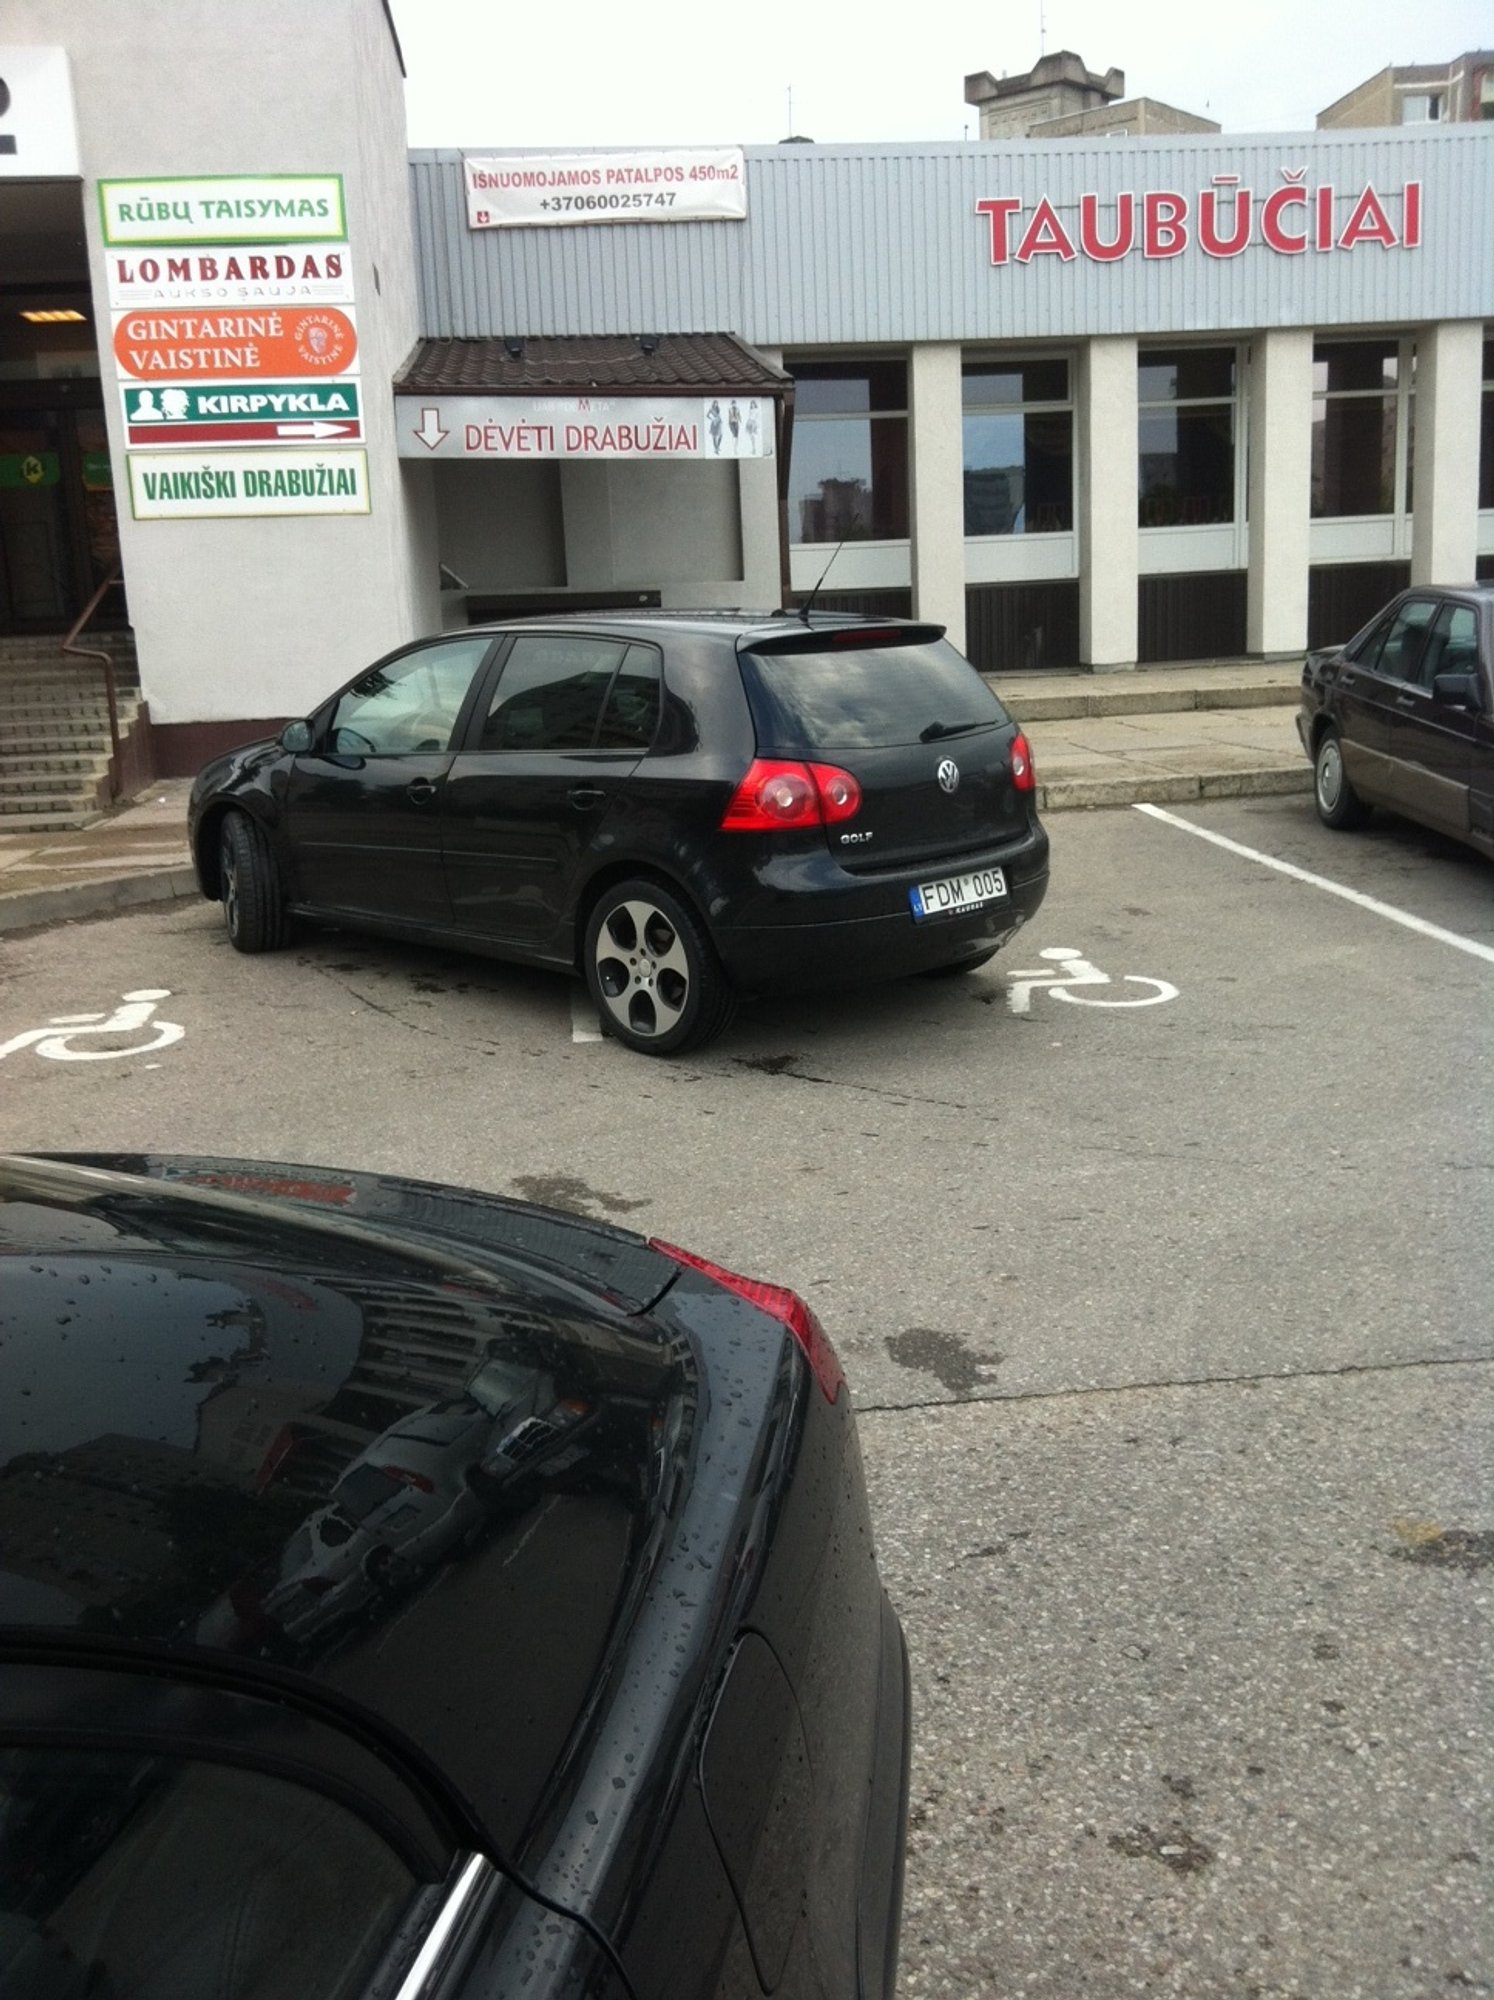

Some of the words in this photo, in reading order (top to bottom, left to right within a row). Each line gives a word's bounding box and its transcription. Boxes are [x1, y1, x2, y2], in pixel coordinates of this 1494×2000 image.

[472, 168, 602, 189] IŠNUOMOJAMOS
[606, 166, 684, 185] PATALPOS
[689, 164, 739, 181] 450m2
[118, 197, 194, 224] RŪBŲ
[199, 198, 330, 219] TAISYMAS
[540, 192, 677, 212] +37060025747
[976, 166, 1421, 266] TAUBŪČIAI
[117, 253, 344, 284] LOMBARDAS
[153, 287, 229, 299] AUKSO
[238, 285, 312, 298] SAUJA
[127, 312, 284, 340] GINTARINĖ
[130, 342, 261, 370] VAISTINĖ
[197, 393, 350, 414] KIRPYKLA
[465, 418, 554, 451] DĖVĖTI
[565, 416, 698, 451] DRABUŽIAI
[143, 465, 237, 500] VAIKIŠKI
[243, 463, 357, 498] DRABUŽIAI
[840, 831, 873, 844] GOLF
[922, 879, 964, 910] FDM
[972, 870, 1003, 897] 005
